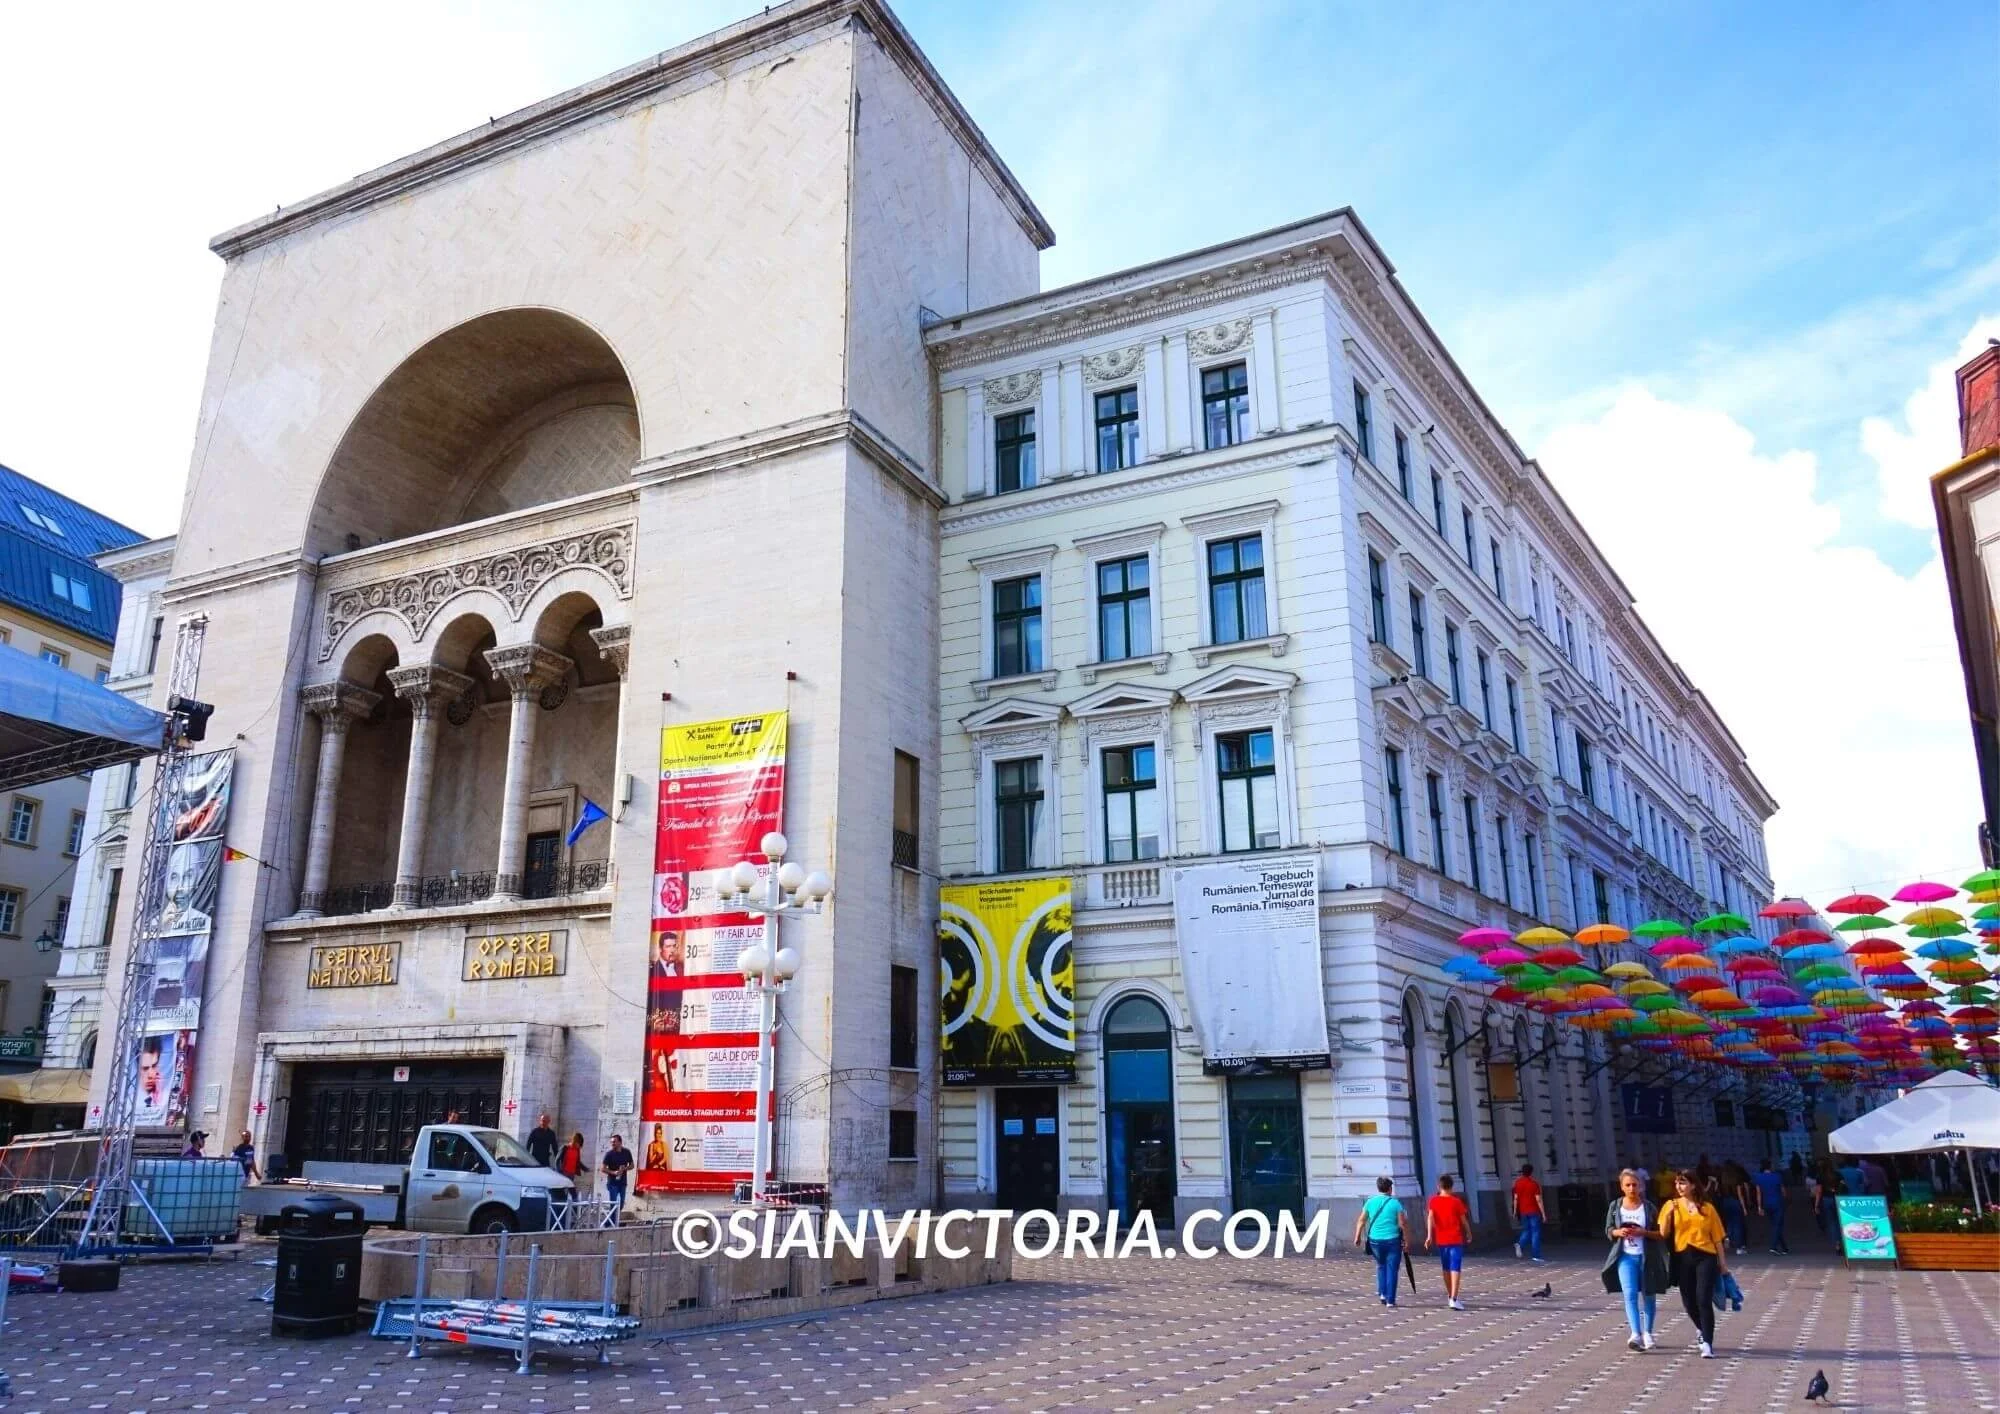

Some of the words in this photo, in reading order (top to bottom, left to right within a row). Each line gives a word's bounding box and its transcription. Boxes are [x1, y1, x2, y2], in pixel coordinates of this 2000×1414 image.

[1260, 869, 1314, 884] Tagebuch
[689, 887, 701, 901] 29
[1265, 889, 1299, 901] Jurnal
[1300, 888, 1314, 897] de
[714, 929, 726, 939] MY
[728, 929, 745, 939] FAIR
[747, 928, 763, 937] LAD
[479, 932, 550, 956] OPERA
[686, 944, 698, 959] 30
[470, 954, 554, 978] ROMANA
[311, 964, 391, 985] NATIONAL
[711, 990, 744, 1001] VOIEVODUL
[682, 1004, 695, 1019] 31
[729, 1051, 740, 1061] DE
[740, 1050, 759, 1061] OPER
[1220, 1059, 1242, 1067] 10.09
[682, 1063, 687, 1078] 1
[705, 1125, 724, 1136] AIDA
[673, 1137, 687, 1153] 22
